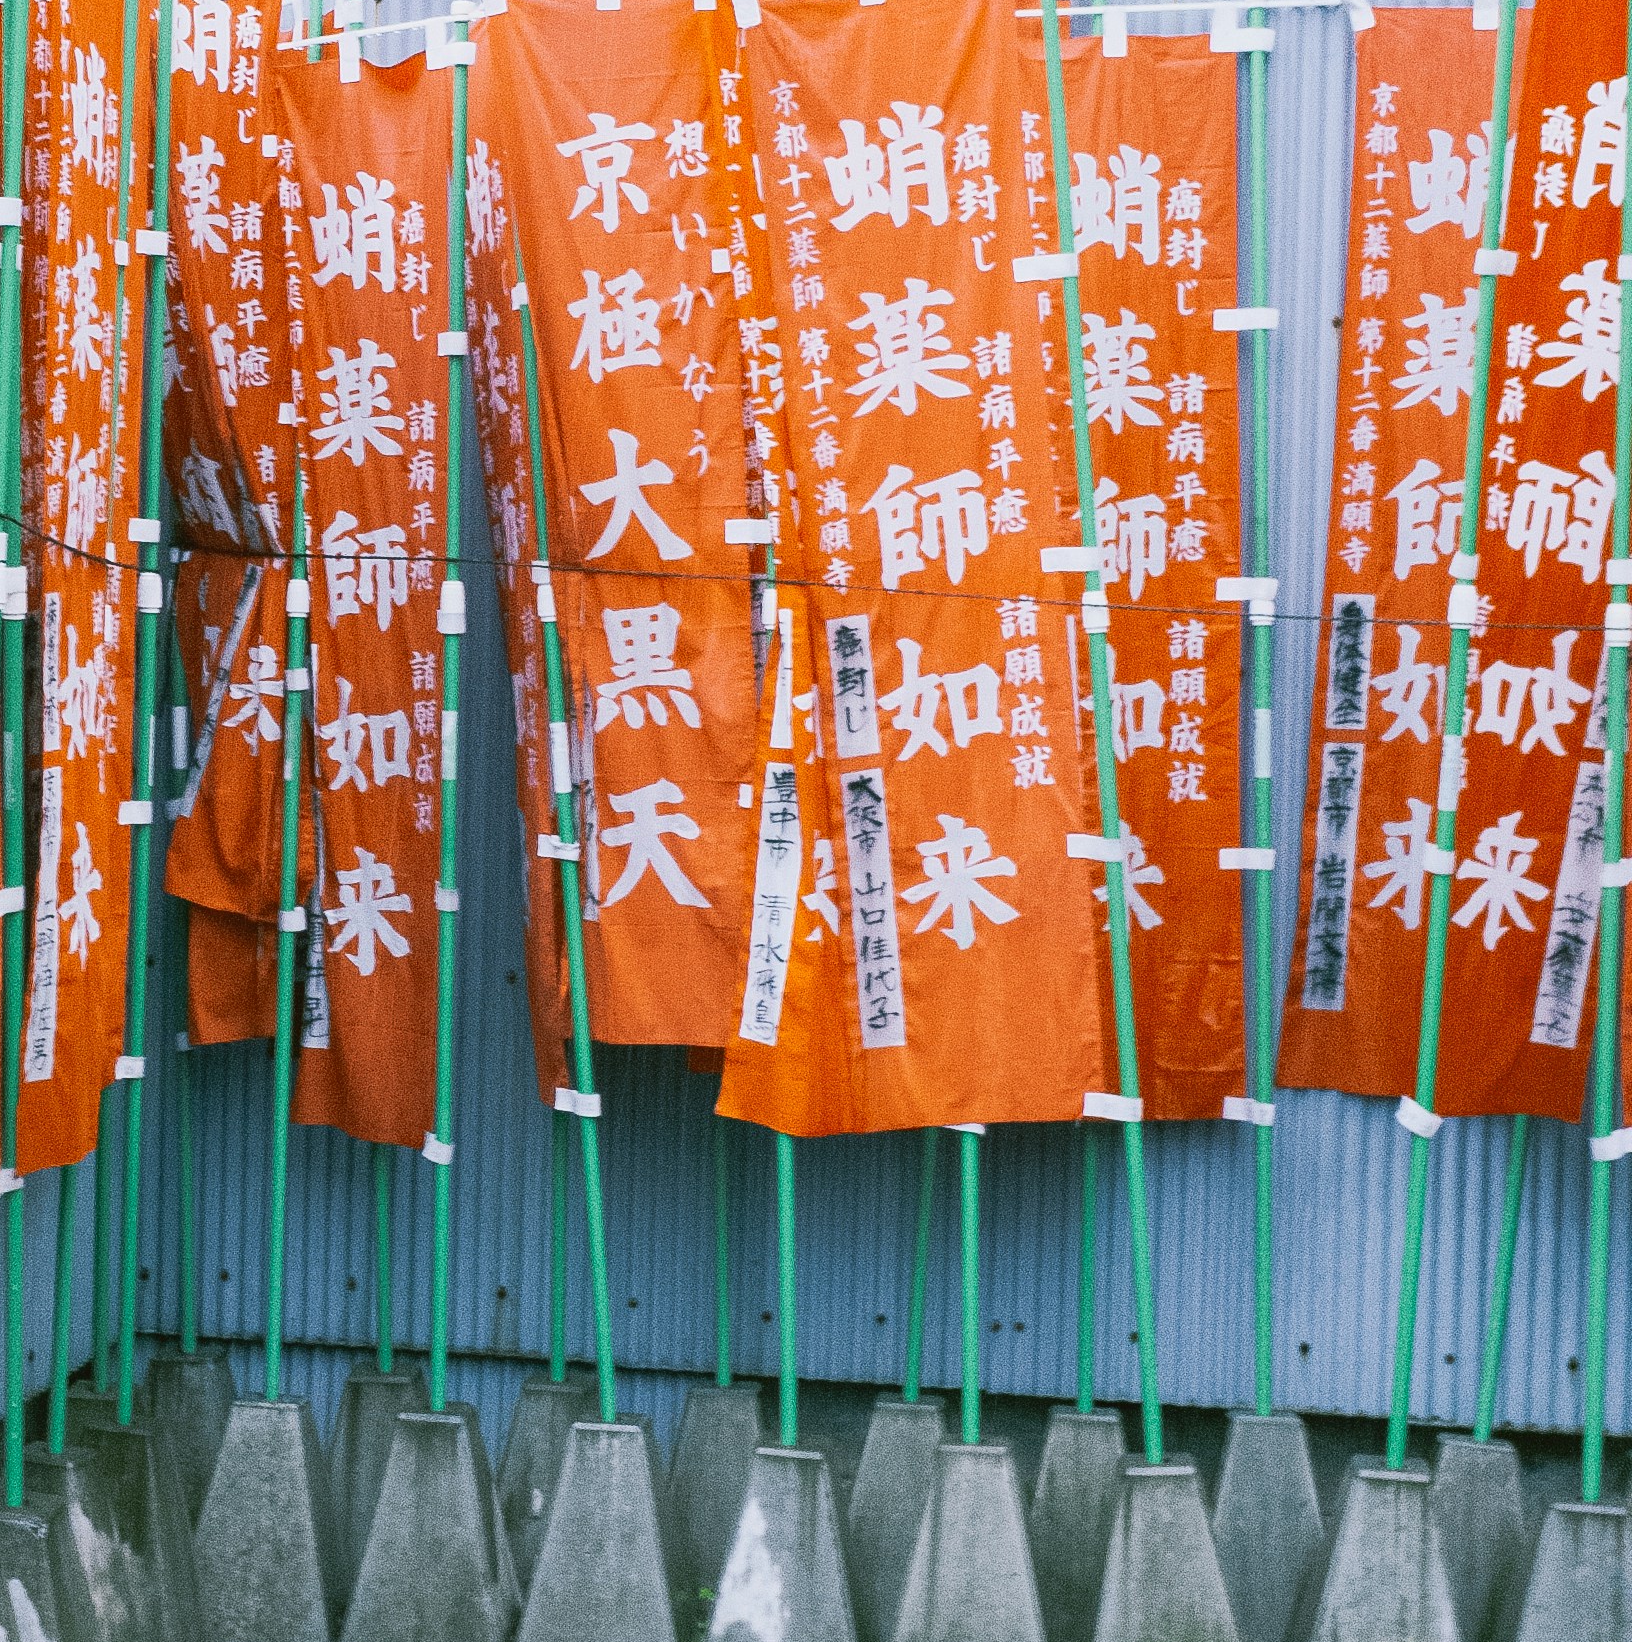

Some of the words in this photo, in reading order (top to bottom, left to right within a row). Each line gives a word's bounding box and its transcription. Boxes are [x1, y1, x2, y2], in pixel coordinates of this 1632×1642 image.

[232, 5, 263, 144] 癌封じ
[399, 202, 432, 341] 癌封じ
[769, 80, 825, 312] 京都十二薬師
[951, 123, 998, 272] 癌封じ
[1165, 179, 1207, 316] 癌封じ
[1358, 82, 1399, 299] 京都十二薬師
[230, 201, 269, 389] 諸病平癒
[665, 119, 715, 477] 想いかなう
[556, 112, 710, 909] 京極大黒天
[824, 100, 1022, 951] 蛸薬師如来
[973, 332, 1028, 535] 諸病平癒
[1165, 372, 1207, 562] 諸病平癒
[310, 171, 413, 977] 蛸薬師如来
[996, 597, 1056, 787] 諸願成就
[1167, 620, 1208, 802] 諸願成就
[764, 769, 797, 868] 豊中市
